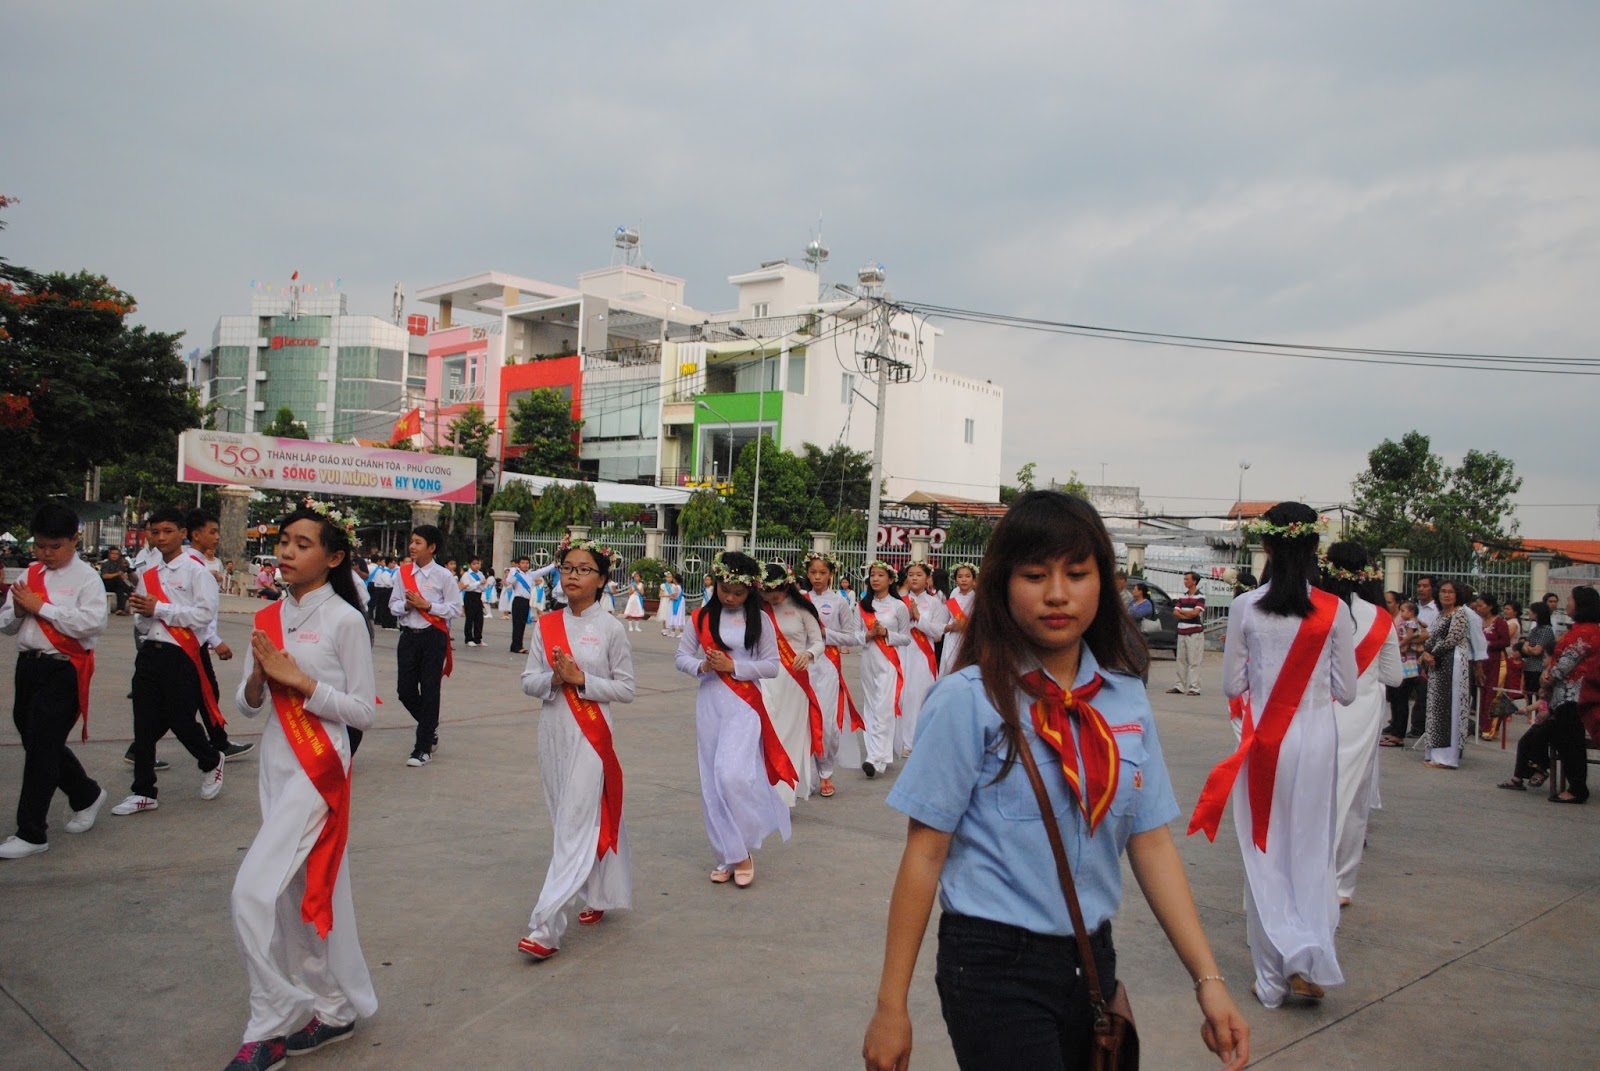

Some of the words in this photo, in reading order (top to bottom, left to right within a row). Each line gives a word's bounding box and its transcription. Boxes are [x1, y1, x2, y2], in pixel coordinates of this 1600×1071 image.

[210, 443, 261, 466] 150
[267, 449, 299, 461] THÀNH
[301, 452, 317, 465] LẬP
[318, 454, 340, 465] GIÁO
[341, 455, 354, 467] XỨ
[355, 458, 384, 470] CHÁNH
[385, 460, 401, 471] TÒA
[424, 464, 452, 476] CƯỜNG
[234, 465, 275, 479] NĂM
[282, 463, 317, 481] SỐNG
[319, 468, 341, 485] VUI
[342, 469, 379, 488] MỪNG
[380, 475, 393, 488] VÀ
[395, 475, 411, 490] HY
[412, 477, 443, 495] VỌNG
